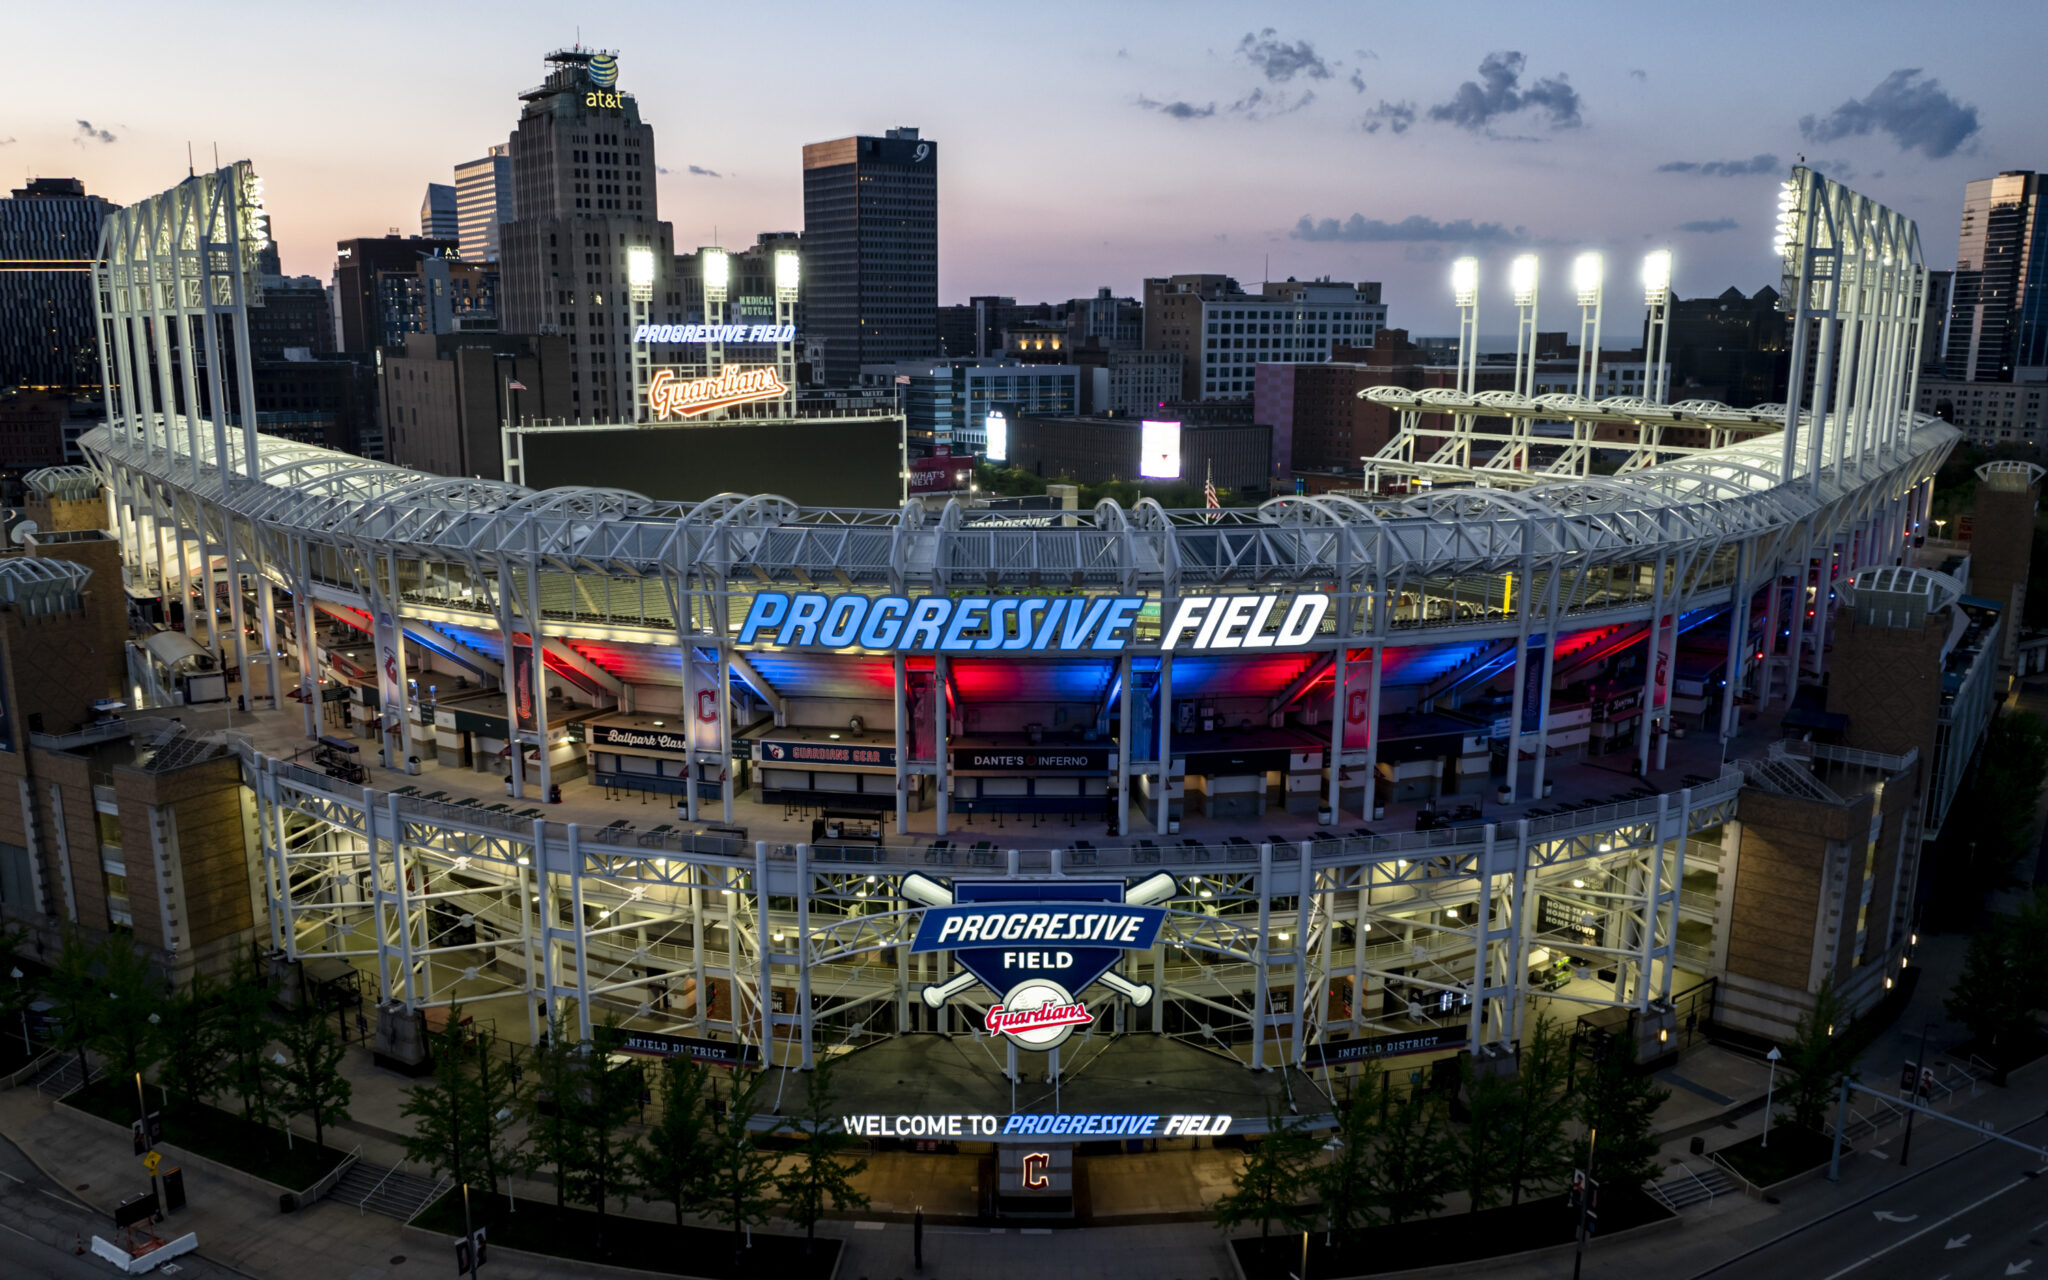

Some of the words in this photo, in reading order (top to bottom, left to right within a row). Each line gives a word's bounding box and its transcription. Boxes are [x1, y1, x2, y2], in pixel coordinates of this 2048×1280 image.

[586, 89, 624, 109] at&t
[739, 296, 774, 305] MEDICAL
[740, 306, 773, 316] MUTUAL
[634, 324, 748, 342] PROGRESSIVE
[748, 324, 796, 342] FIELD
[649, 364, 788, 420] Guardians
[911, 470, 945, 480] WHAT'S
[911, 478, 935, 487] NEXT
[738, 593, 1144, 650] PROGRESSIVE
[1161, 594, 1329, 650] FIELD
[696, 689, 717, 723] C
[1347, 690, 1367, 724] C
[608, 729, 656, 746] Ballpark
[792, 746, 849, 761] GUARDIANS
[852, 750, 881, 763] GEAR
[974, 755, 1024, 766] DANTE'S
[1038, 756, 1088, 766] INFERNO
[1546, 908, 1570, 919] HOME
[937, 914, 1145, 943] PROGRESSIVE
[1571, 923, 1596, 936] TOWN
[1003, 952, 1073, 969] FIELD
[984, 999, 1095, 1037] Guardians
[1337, 1044, 1383, 1058] INFIED
[1387, 1036, 1439, 1052] DISTRICT
[843, 1115, 962, 1136] WELCOME
[968, 1115, 997, 1136] TO
[1002, 1115, 1159, 1135] PROGRESSIVE
[1163, 1115, 1232, 1136] FIELD
[1022, 1152, 1049, 1191] C
